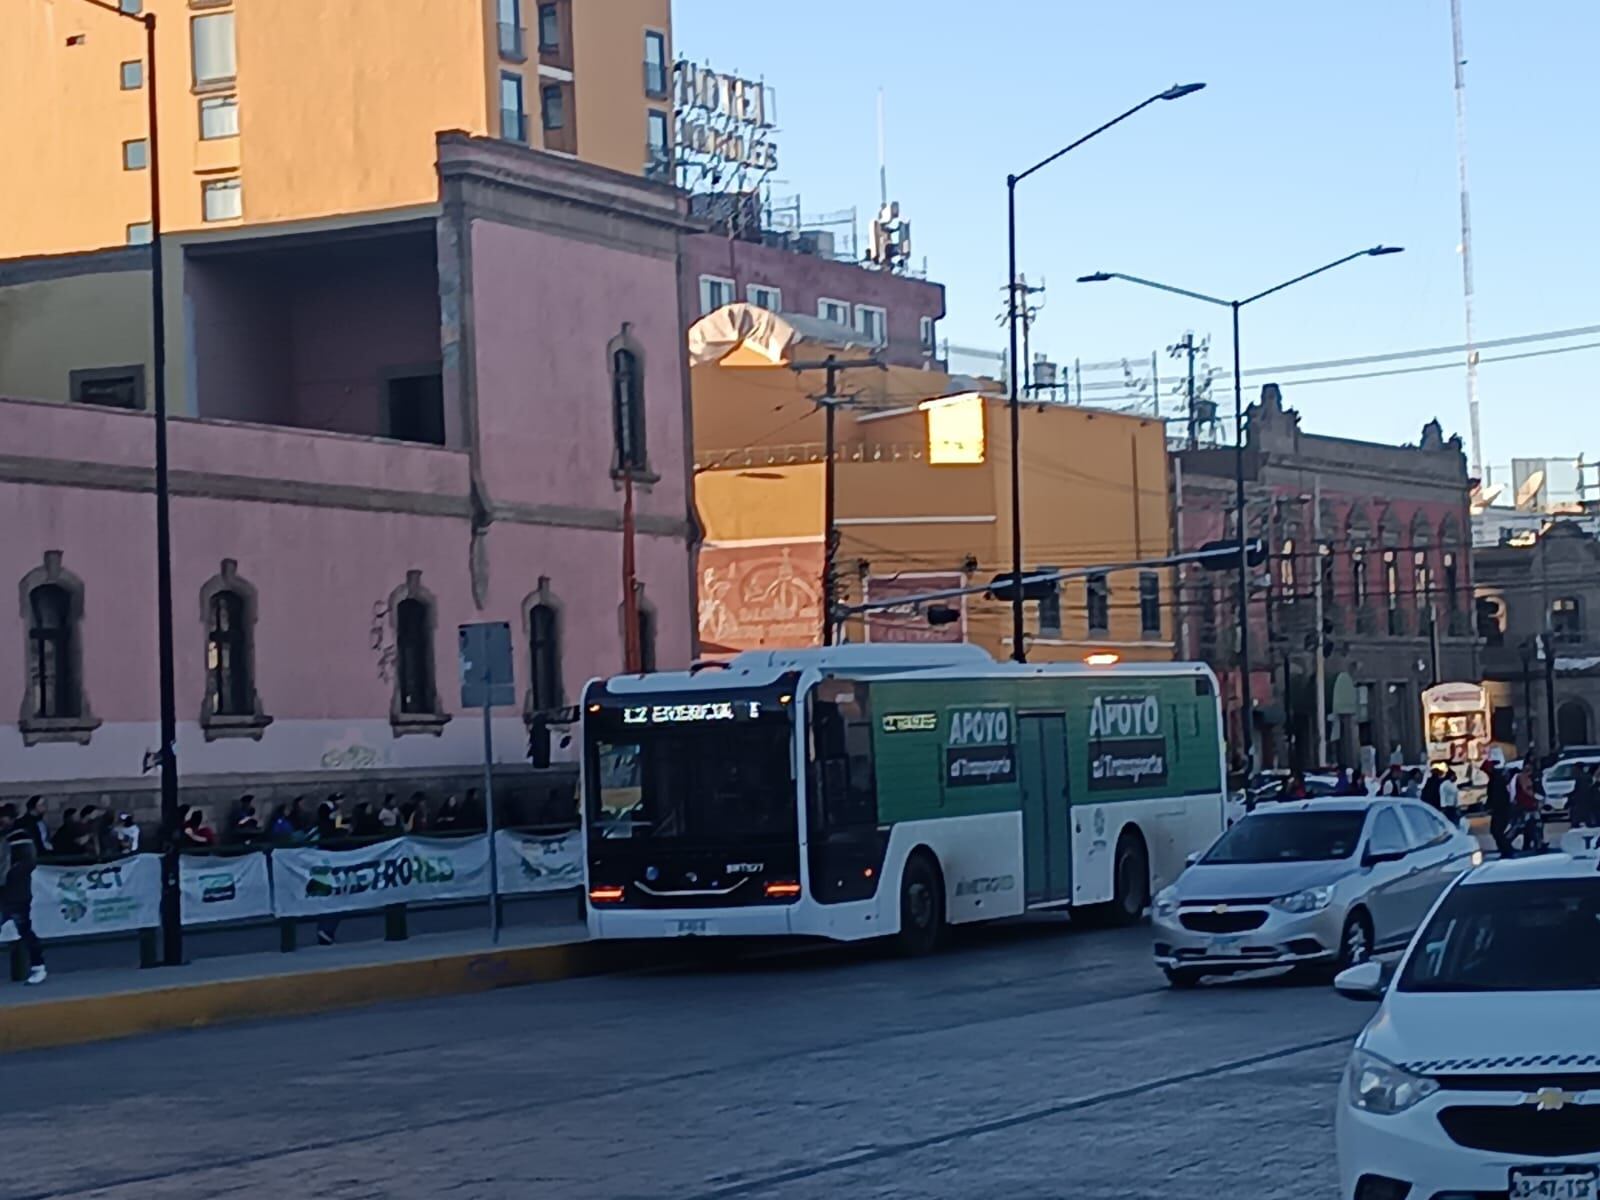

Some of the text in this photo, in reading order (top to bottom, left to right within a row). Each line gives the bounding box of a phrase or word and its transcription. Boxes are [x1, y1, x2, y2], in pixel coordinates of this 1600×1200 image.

[949, 710, 1008, 745] APOYO
[1090, 695, 1159, 737] APOYO
[86, 866, 122, 890] SCT
